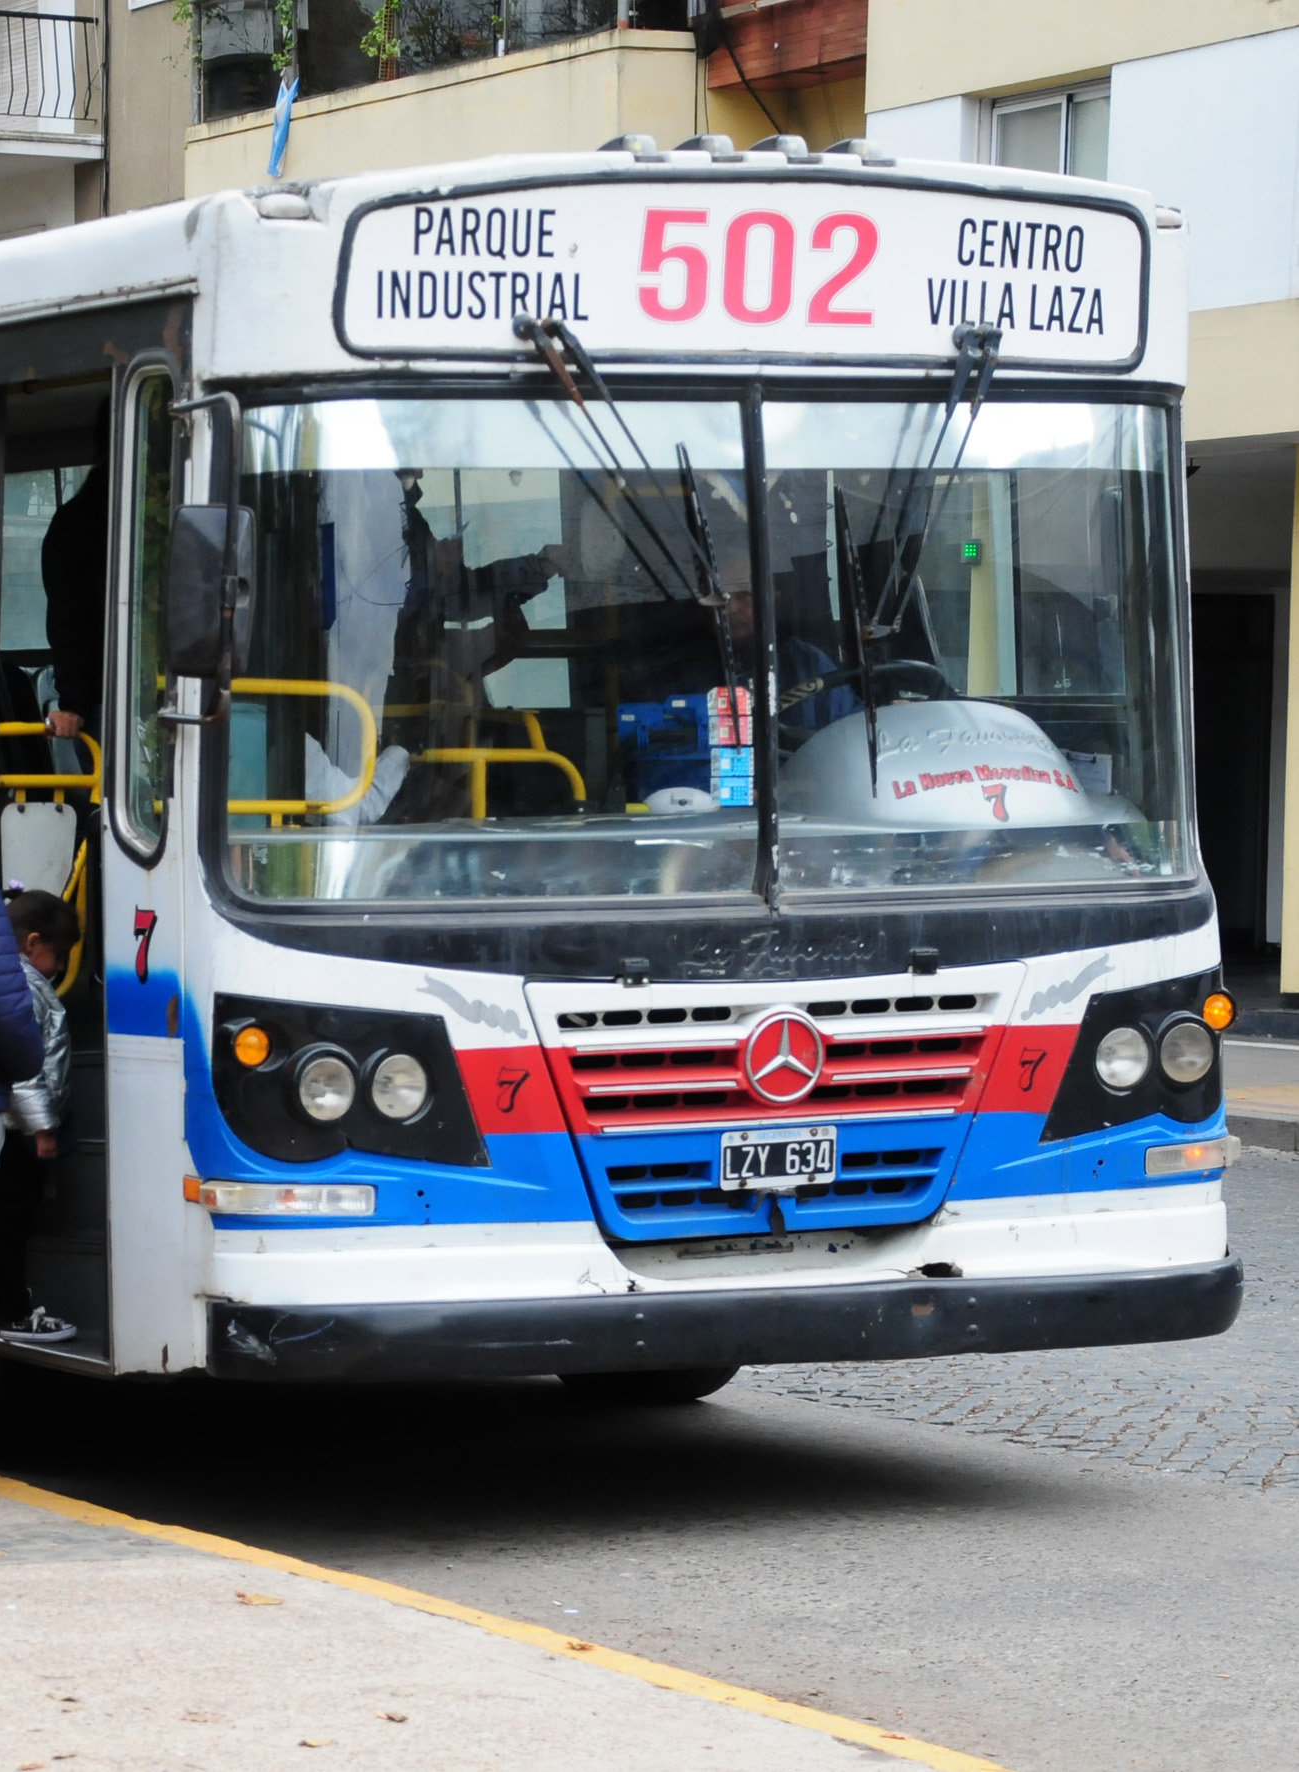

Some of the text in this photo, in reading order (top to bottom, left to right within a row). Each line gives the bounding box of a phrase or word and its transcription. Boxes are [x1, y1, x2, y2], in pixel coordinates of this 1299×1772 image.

[414, 206, 556, 260] PARQUE
[957, 218, 1084, 273] CENTRO
[637, 206, 881, 327] 502
[377, 271, 589, 321] INDUSTRIAL
[928, 278, 1104, 335] VILLA LAZA
[892, 780, 918, 800] La
[918, 768, 974, 791] Nueva
[974, 764, 1052, 785] Movediza
[981, 783, 1010, 822] 7
[133, 904, 158, 985] 7
[495, 1065, 531, 1114] 7
[1018, 1046, 1048, 1093] 7
[726, 1140, 831, 1179] LZY 634
